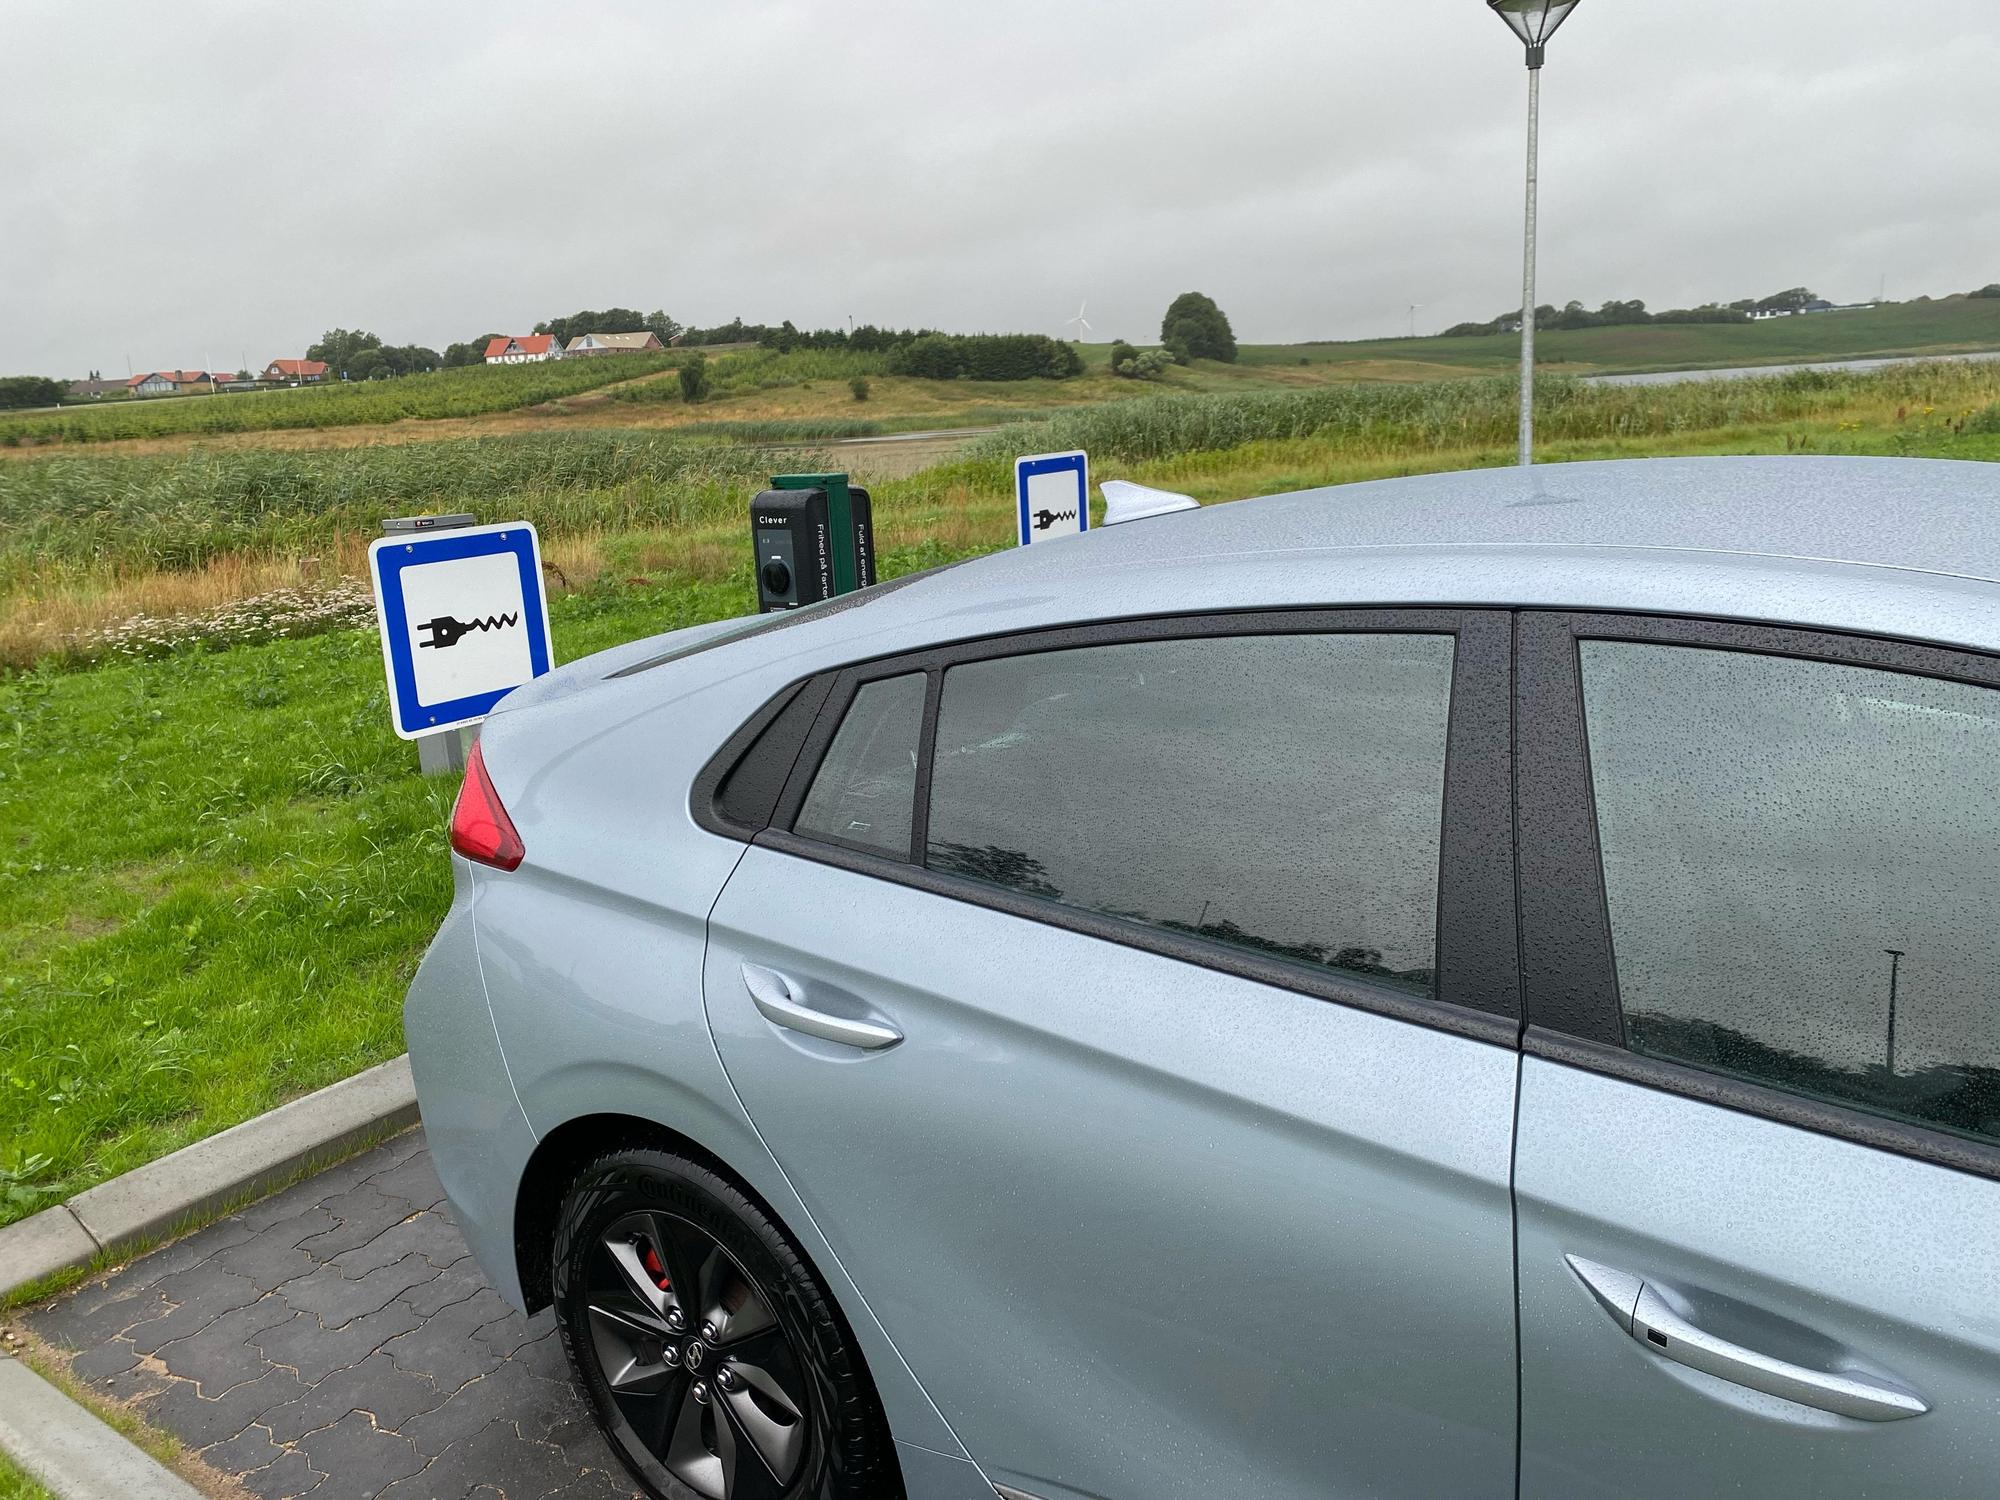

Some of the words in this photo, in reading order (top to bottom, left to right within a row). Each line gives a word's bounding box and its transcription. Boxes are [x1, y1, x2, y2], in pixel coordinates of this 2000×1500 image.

[759, 516, 788, 524] Clever
[818, 524, 826, 555] Frihed
[819, 558, 828, 570] på
